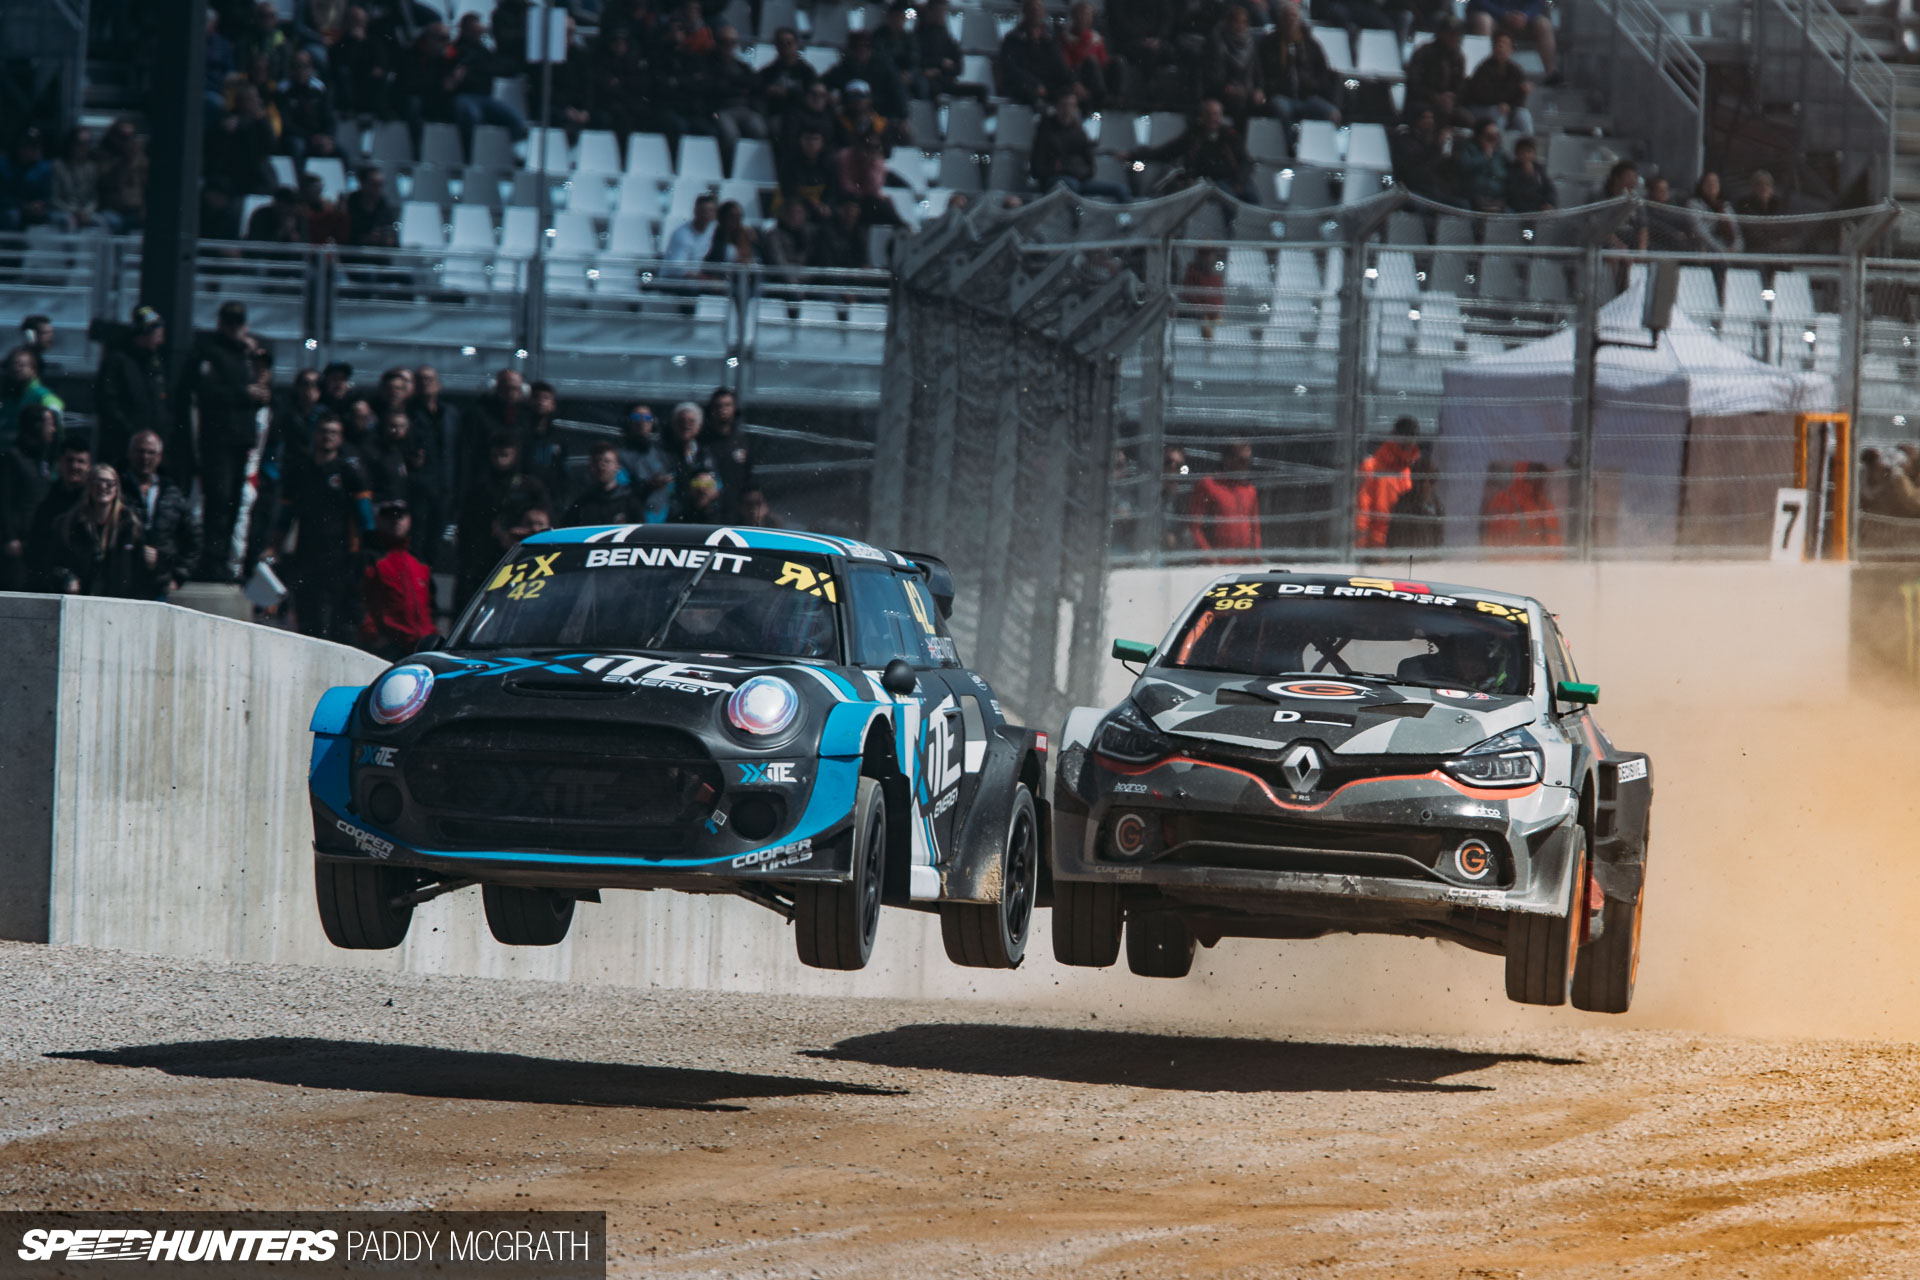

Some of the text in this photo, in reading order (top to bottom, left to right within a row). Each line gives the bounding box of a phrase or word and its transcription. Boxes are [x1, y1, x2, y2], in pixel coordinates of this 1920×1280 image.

[1781, 503, 1801, 549] 7
[585, 547, 752, 574] BENNETT
[507, 579, 546, 600] 42
[1278, 583, 1458, 606] DE RIDDER
[1213, 598, 1254, 611] 96
[601, 674, 720, 697] ENERGY
[933, 786, 959, 820] ENERGY
[336, 819, 395, 856] COOPER
[732, 838, 812, 869] COOPER
